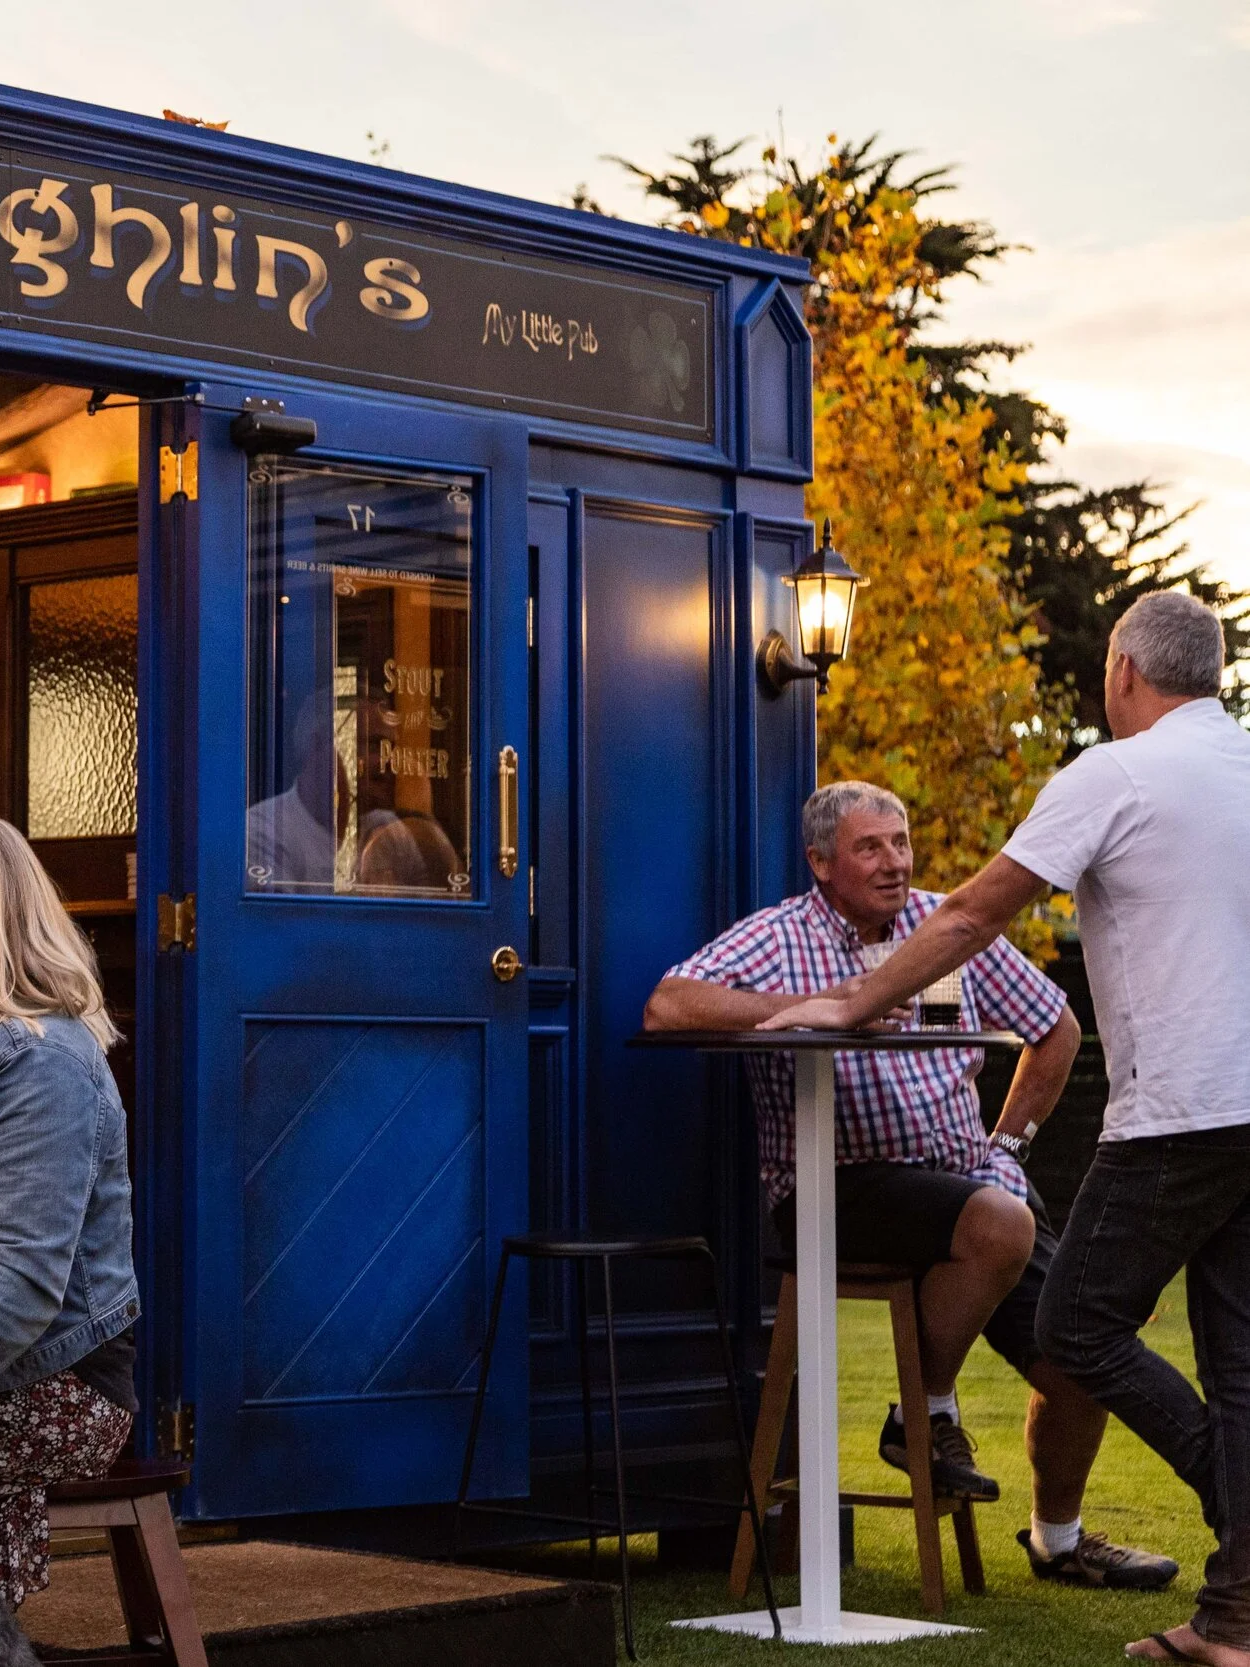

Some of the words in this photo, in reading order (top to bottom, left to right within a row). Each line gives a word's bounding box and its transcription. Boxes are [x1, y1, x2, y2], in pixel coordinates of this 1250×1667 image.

[482, 302, 518, 346] My
[522, 309, 564, 352] Little
[567, 319, 599, 361] Pub
[383, 658, 444, 698] STOUT
[379, 739, 449, 779] PORTER
